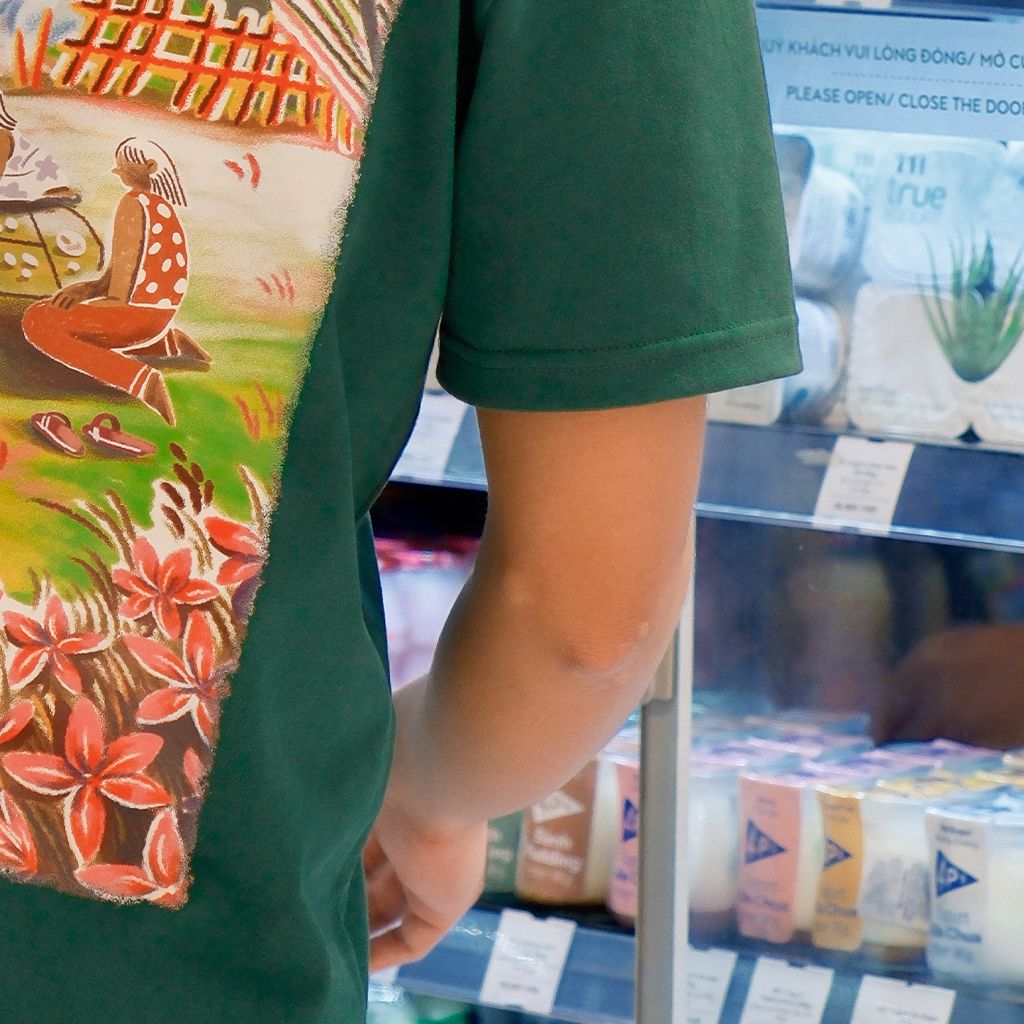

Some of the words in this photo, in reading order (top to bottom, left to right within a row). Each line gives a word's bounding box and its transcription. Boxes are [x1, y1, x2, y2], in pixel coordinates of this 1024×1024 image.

[762, 37, 784, 54] UÝ
[788, 38, 841, 57] KHÁCH
[844, 44, 870, 59] VUI
[873, 43, 916, 63] LÒNG
[1009, 54, 1024, 70] C
[786, 85, 841, 104] PLEASE
[844, 88, 895, 107] OPEN/
[898, 93, 949, 112] CLOSE
[952, 96, 982, 113] THE
[985, 98, 1024, 116] DOO
